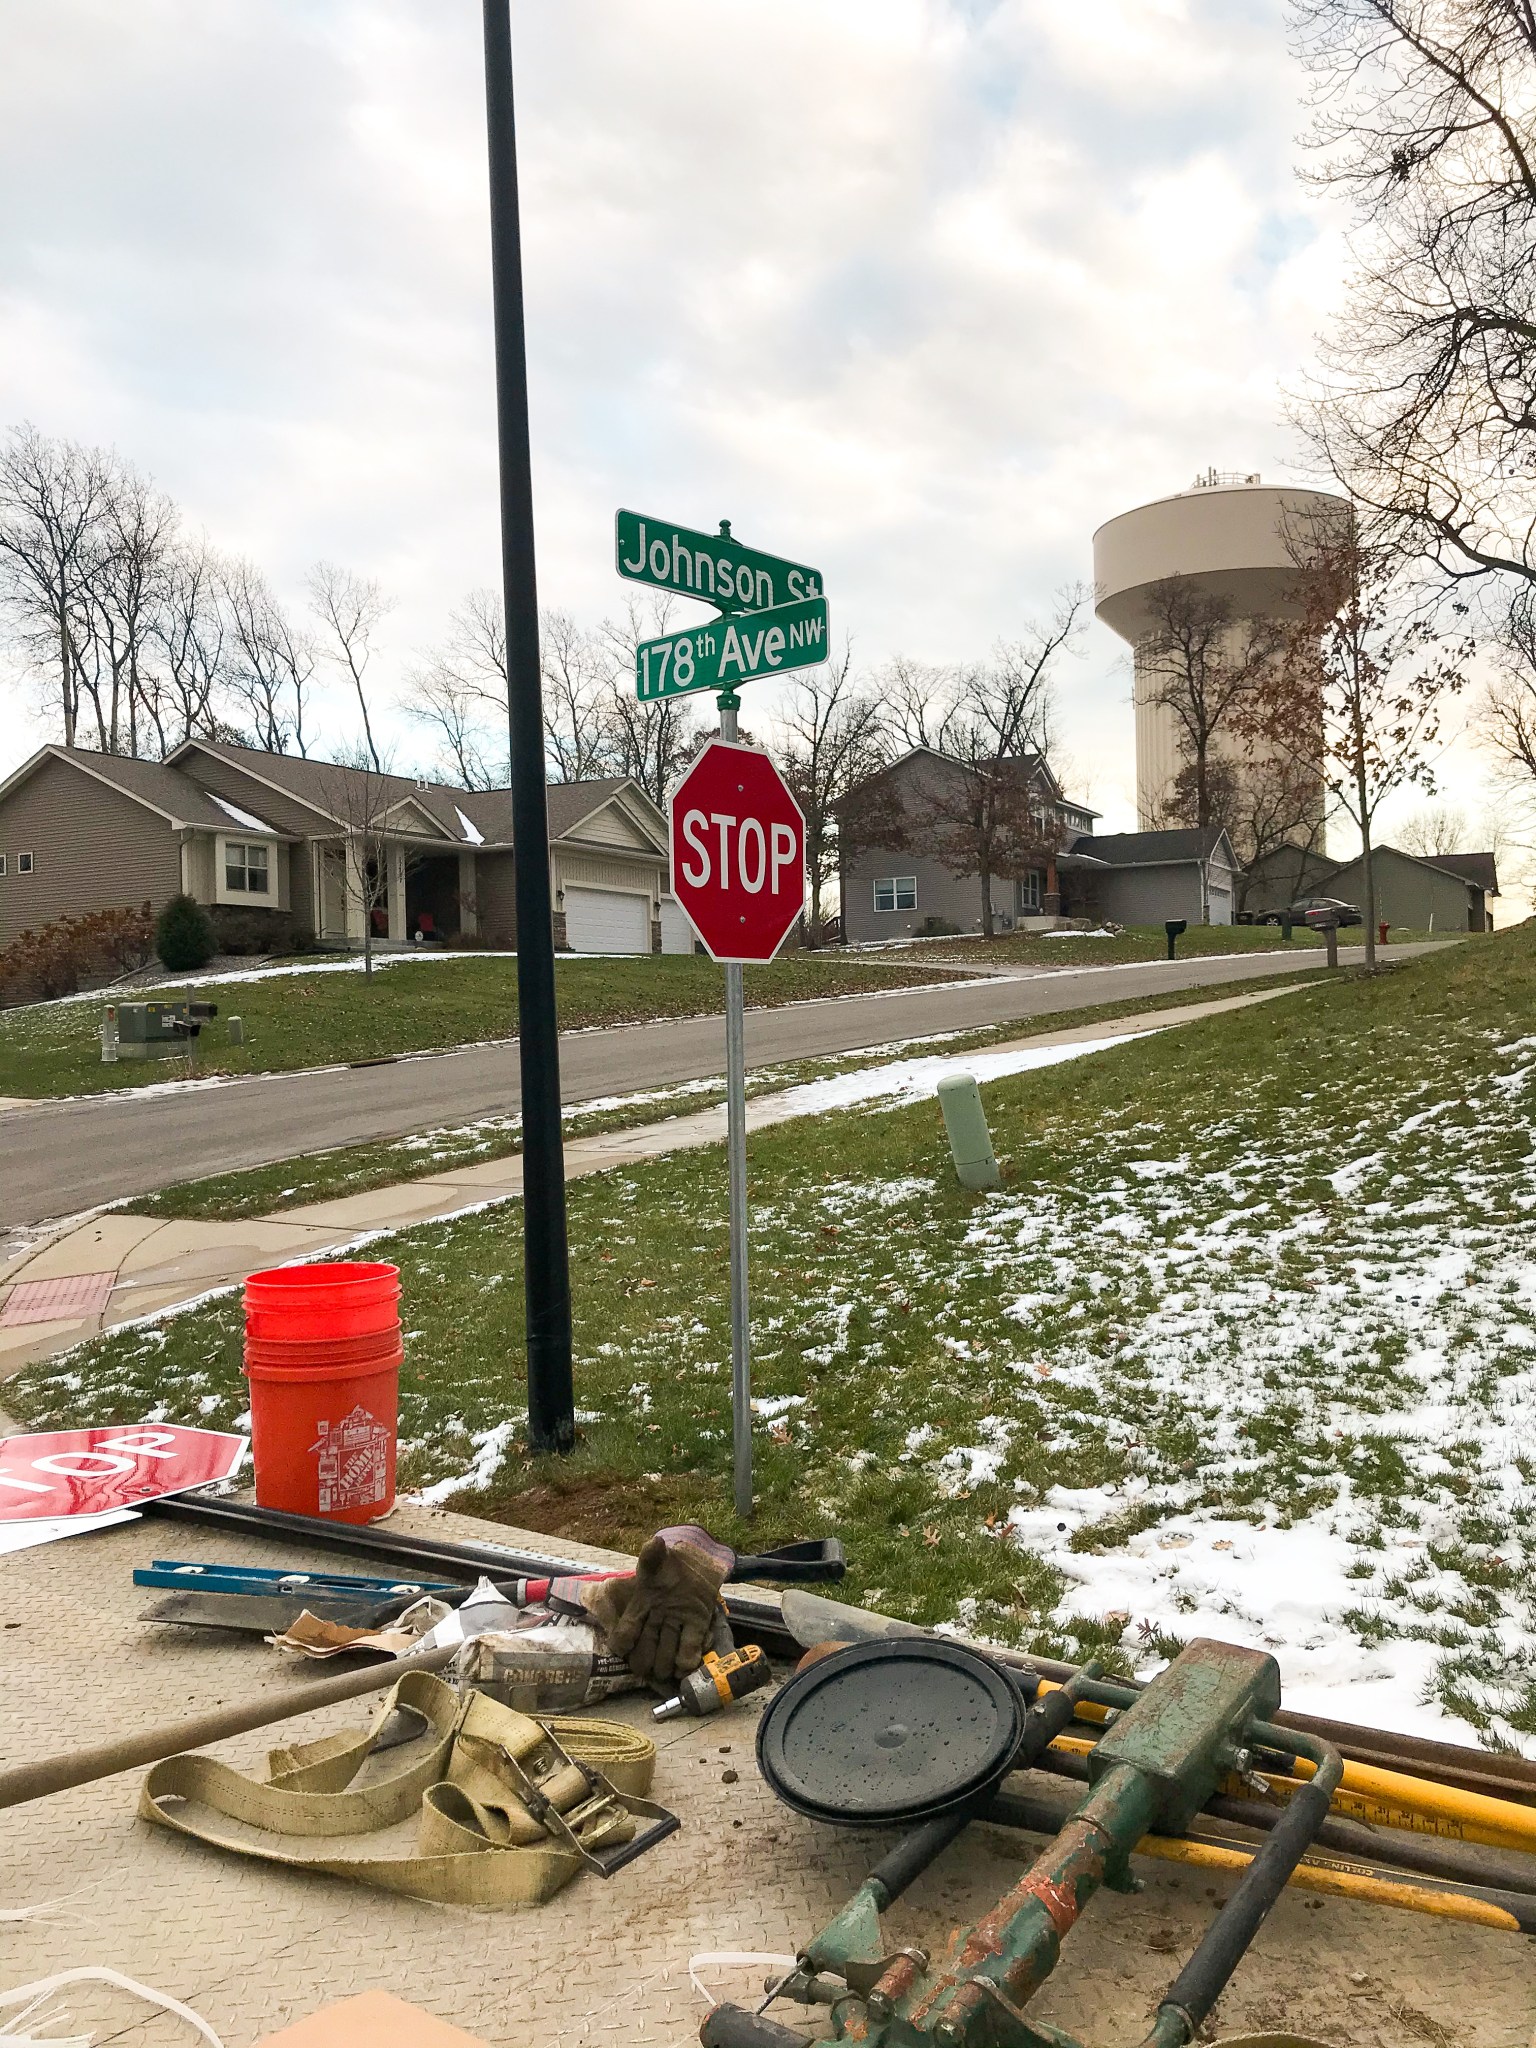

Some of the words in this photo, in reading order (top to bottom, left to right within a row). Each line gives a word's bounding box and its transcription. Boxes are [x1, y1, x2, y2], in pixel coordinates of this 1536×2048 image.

[623, 522, 774, 608] Johnson
[787, 569, 819, 600] St
[640, 632, 716, 696] 178th
[717, 625, 786, 678] Ave
[789, 616, 822, 650] NW
[681, 808, 797, 895] STOP
